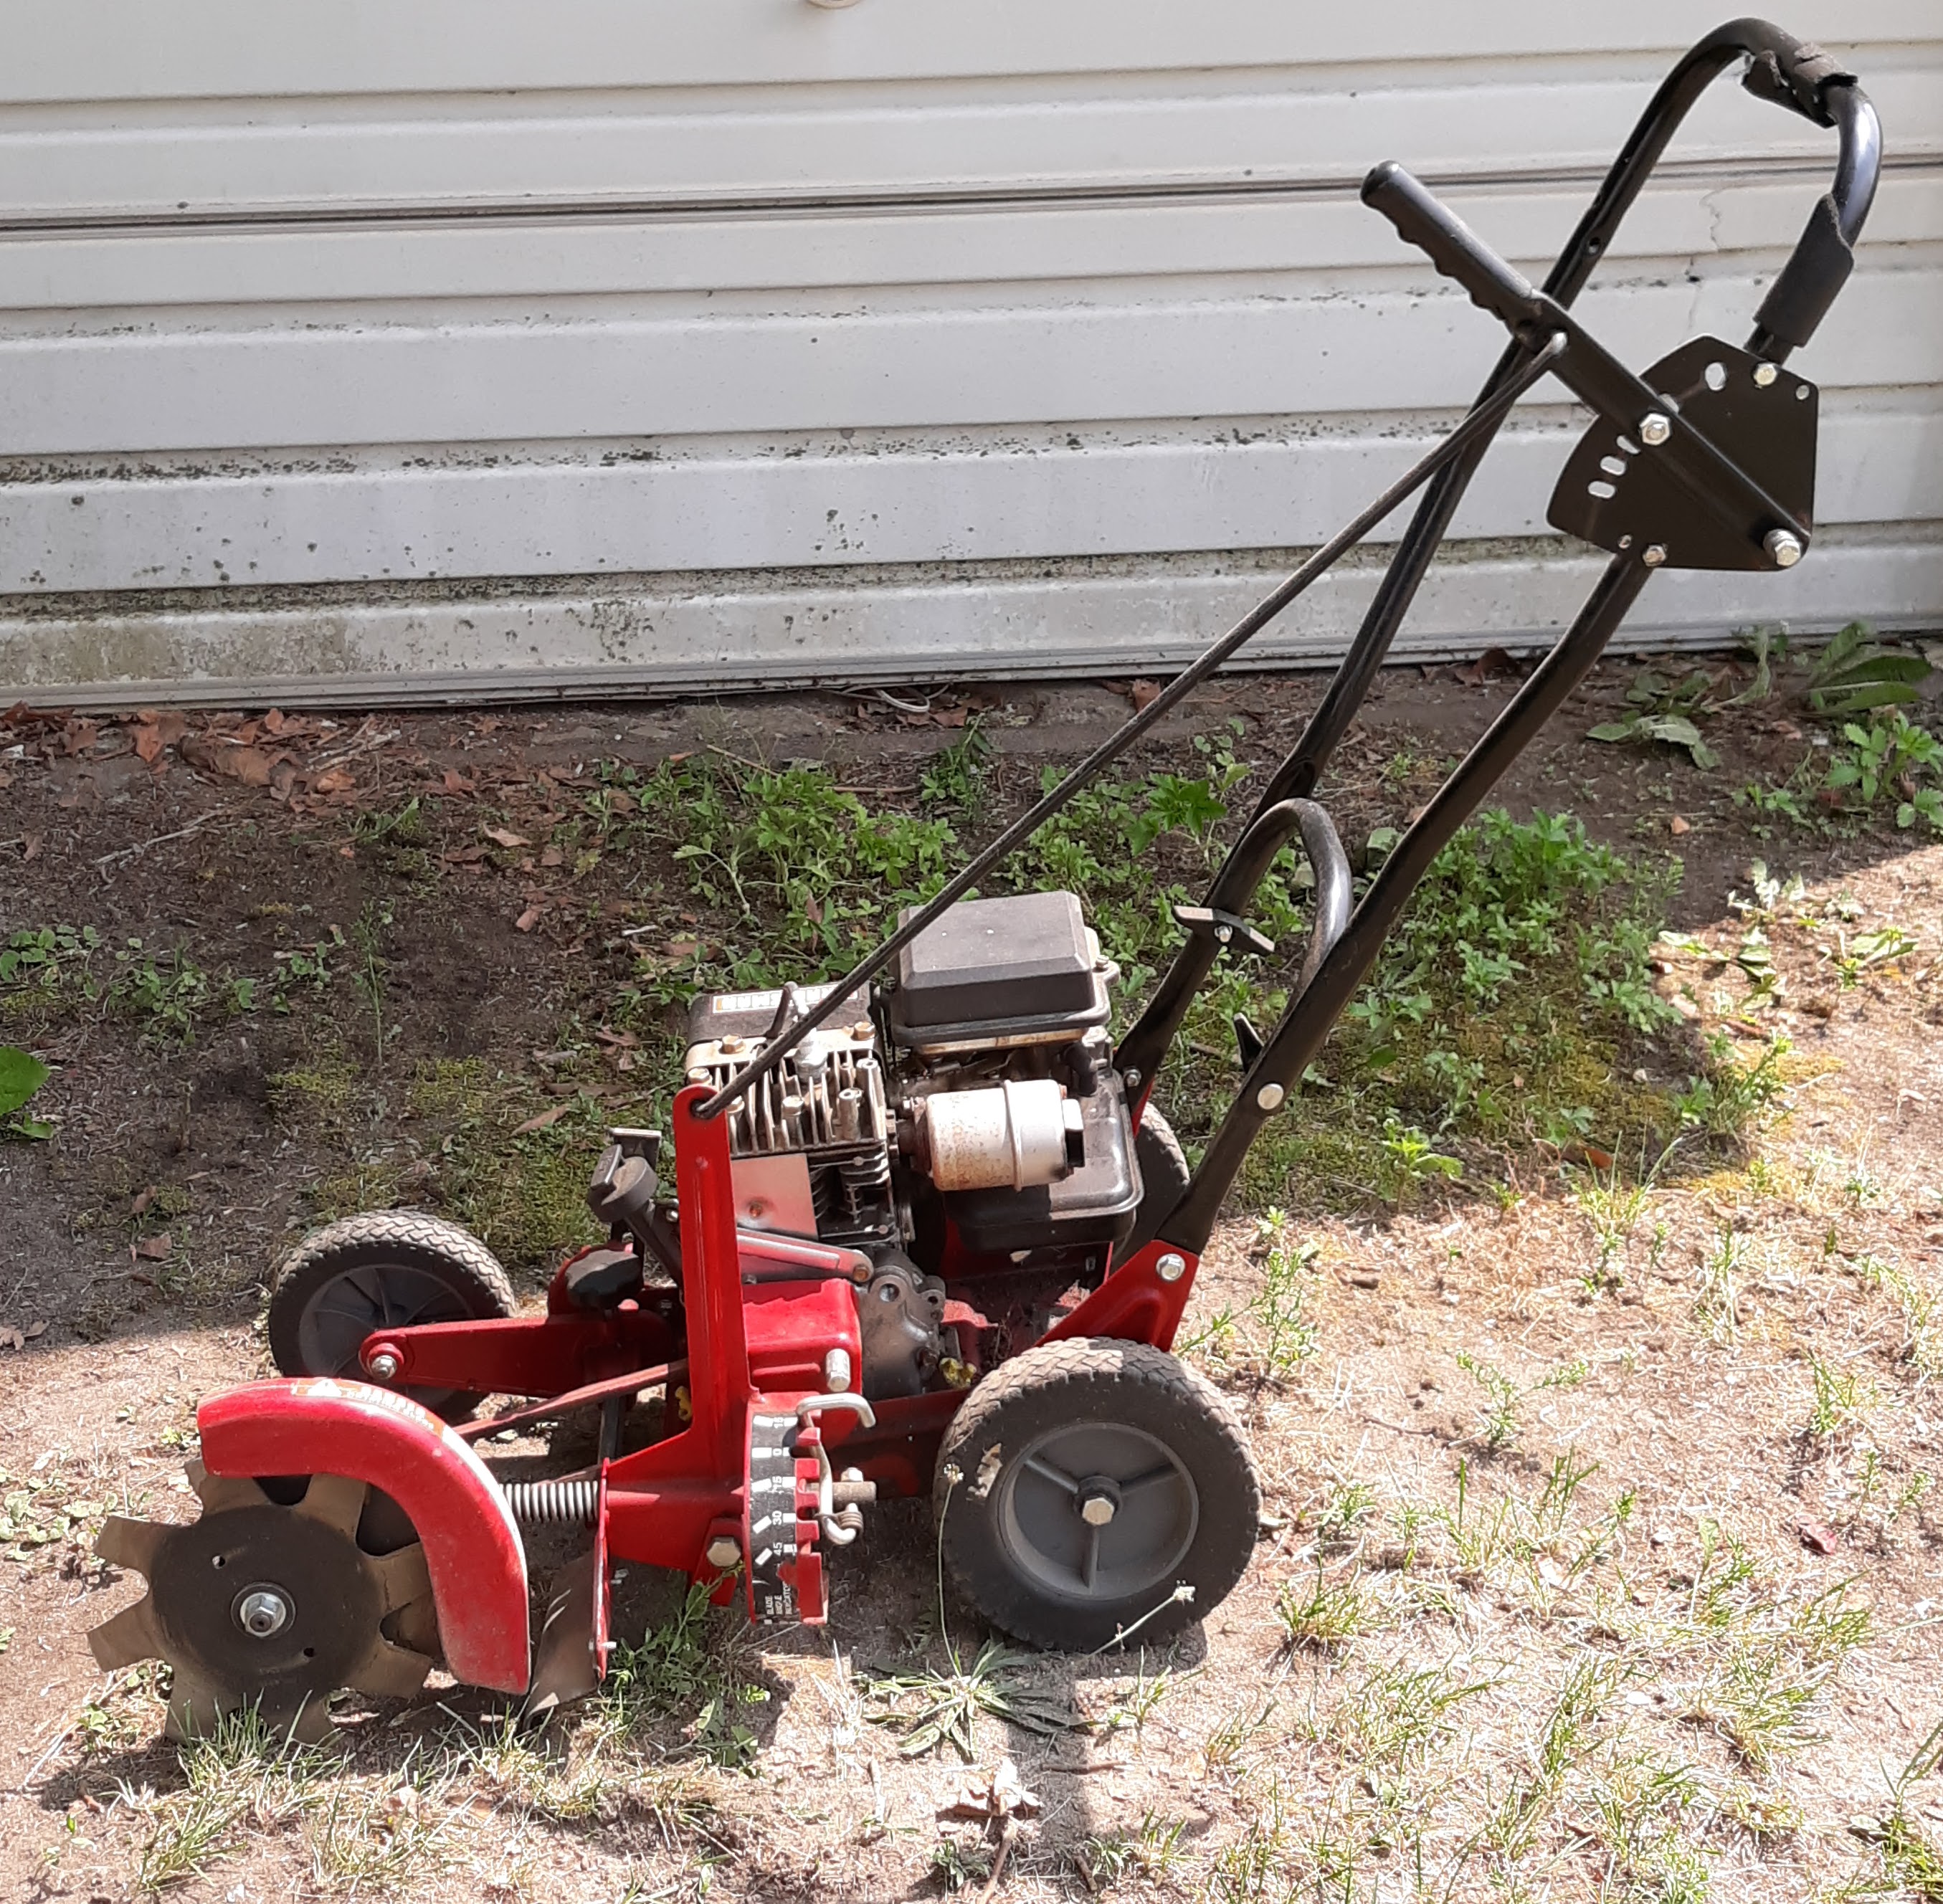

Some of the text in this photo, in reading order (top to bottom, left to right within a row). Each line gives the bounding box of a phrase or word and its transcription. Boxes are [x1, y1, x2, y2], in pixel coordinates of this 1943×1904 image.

[773, 1448, 782, 1457] 0
[773, 1510, 782, 1525] 30
[773, 1542, 782, 1556] 45
